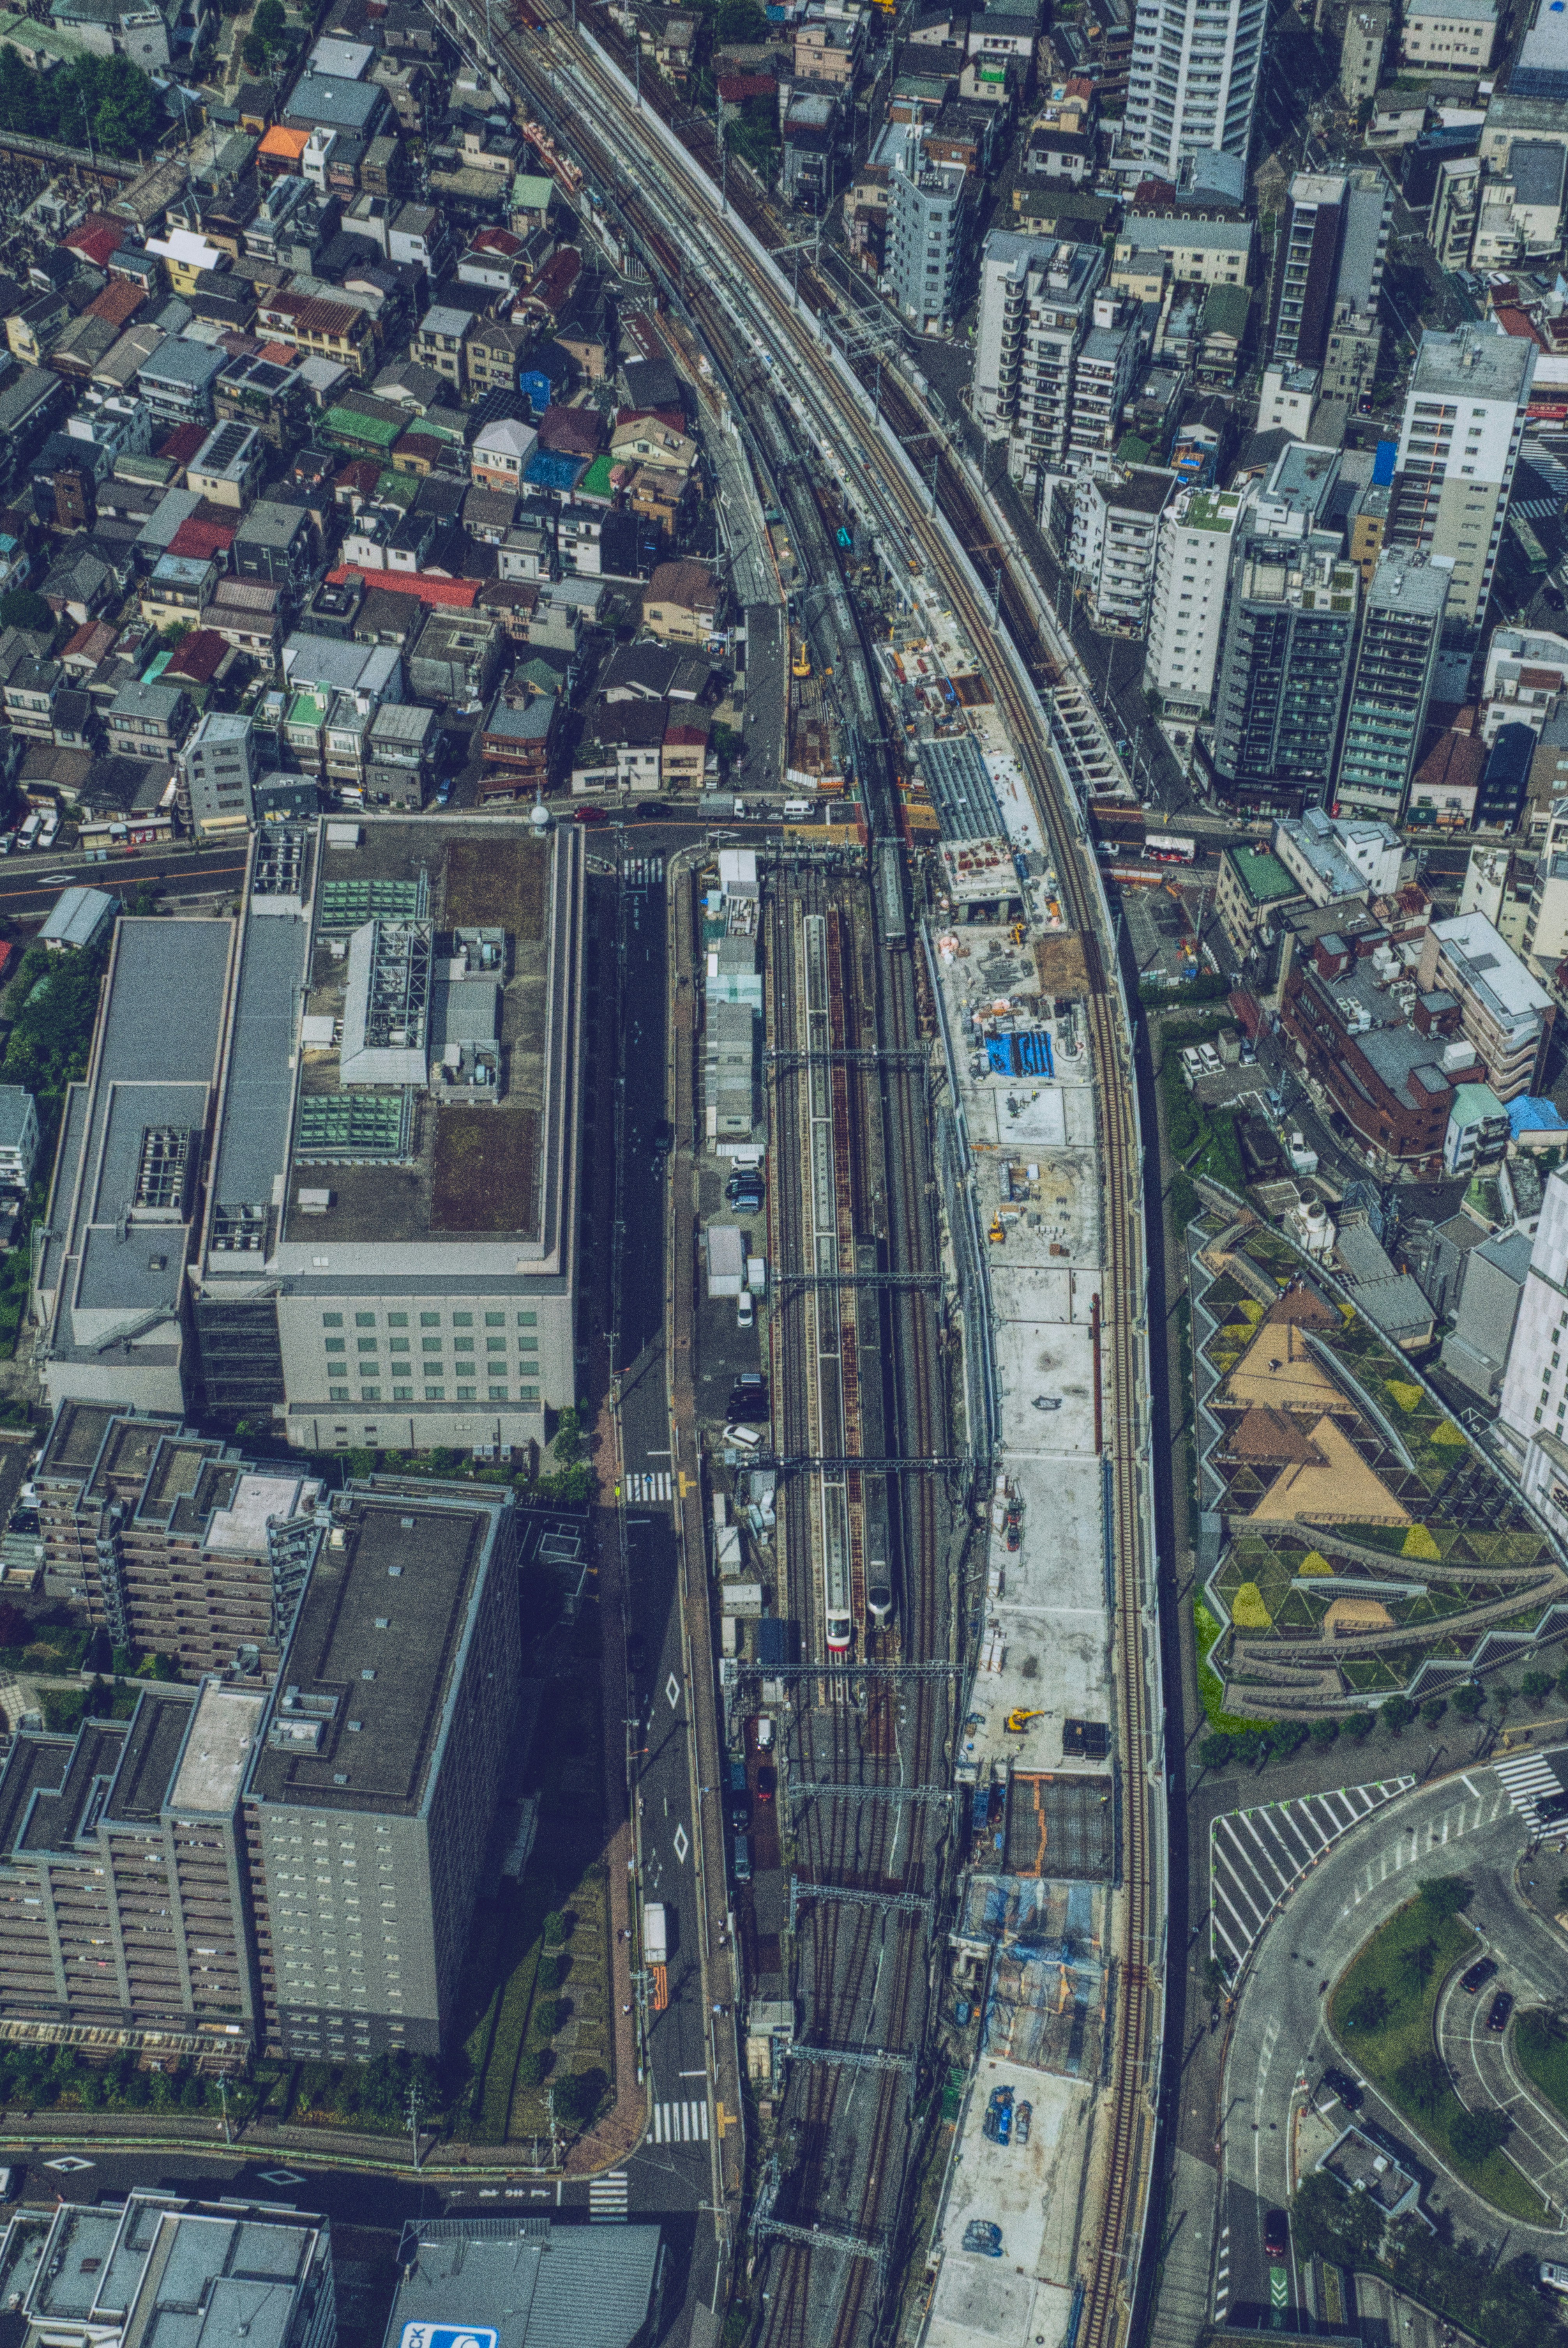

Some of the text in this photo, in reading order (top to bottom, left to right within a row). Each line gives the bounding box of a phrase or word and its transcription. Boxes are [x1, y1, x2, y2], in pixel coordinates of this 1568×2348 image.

[653, 1966, 667, 2010] 30
[479, 2189, 551, 2198] 止まれ
